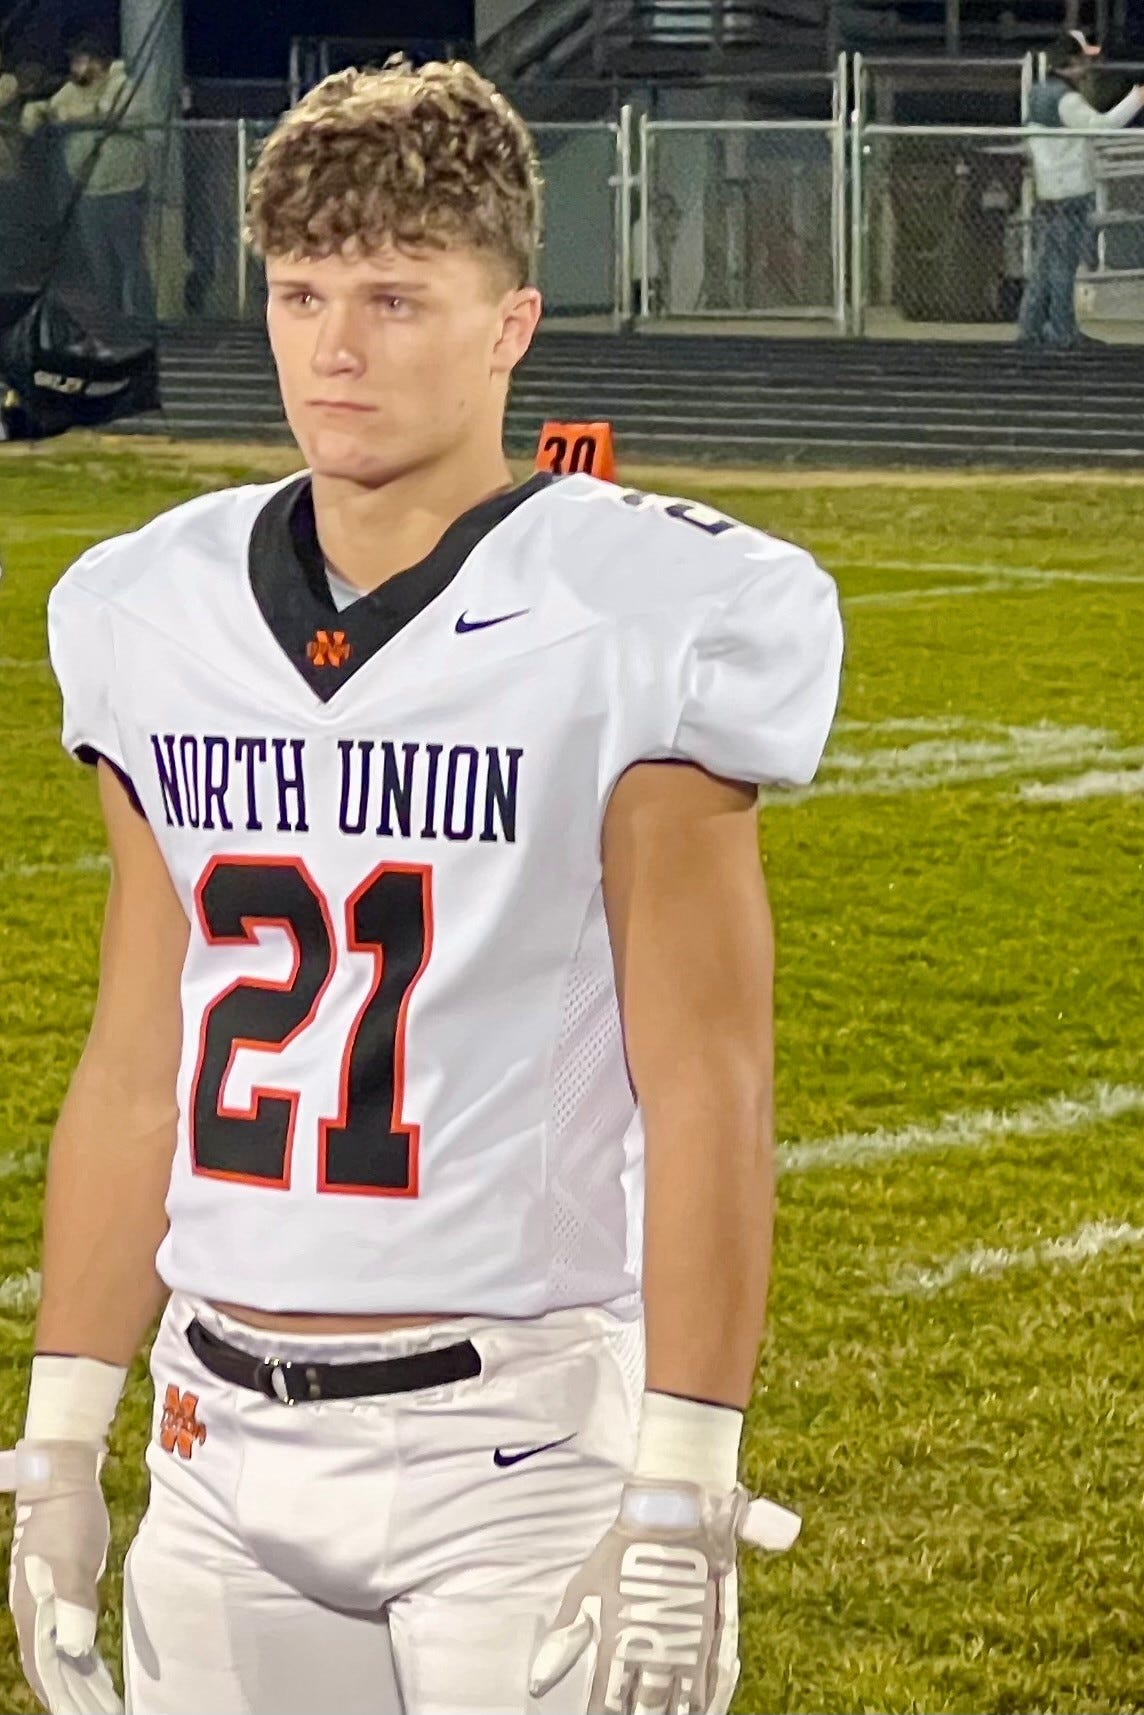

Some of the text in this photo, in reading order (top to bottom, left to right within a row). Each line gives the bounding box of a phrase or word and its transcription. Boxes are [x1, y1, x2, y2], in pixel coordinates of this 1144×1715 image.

[543, 435, 597, 475] 30
[150, 734, 523, 843] NORTH UNION
[189, 854, 434, 1199] 21
